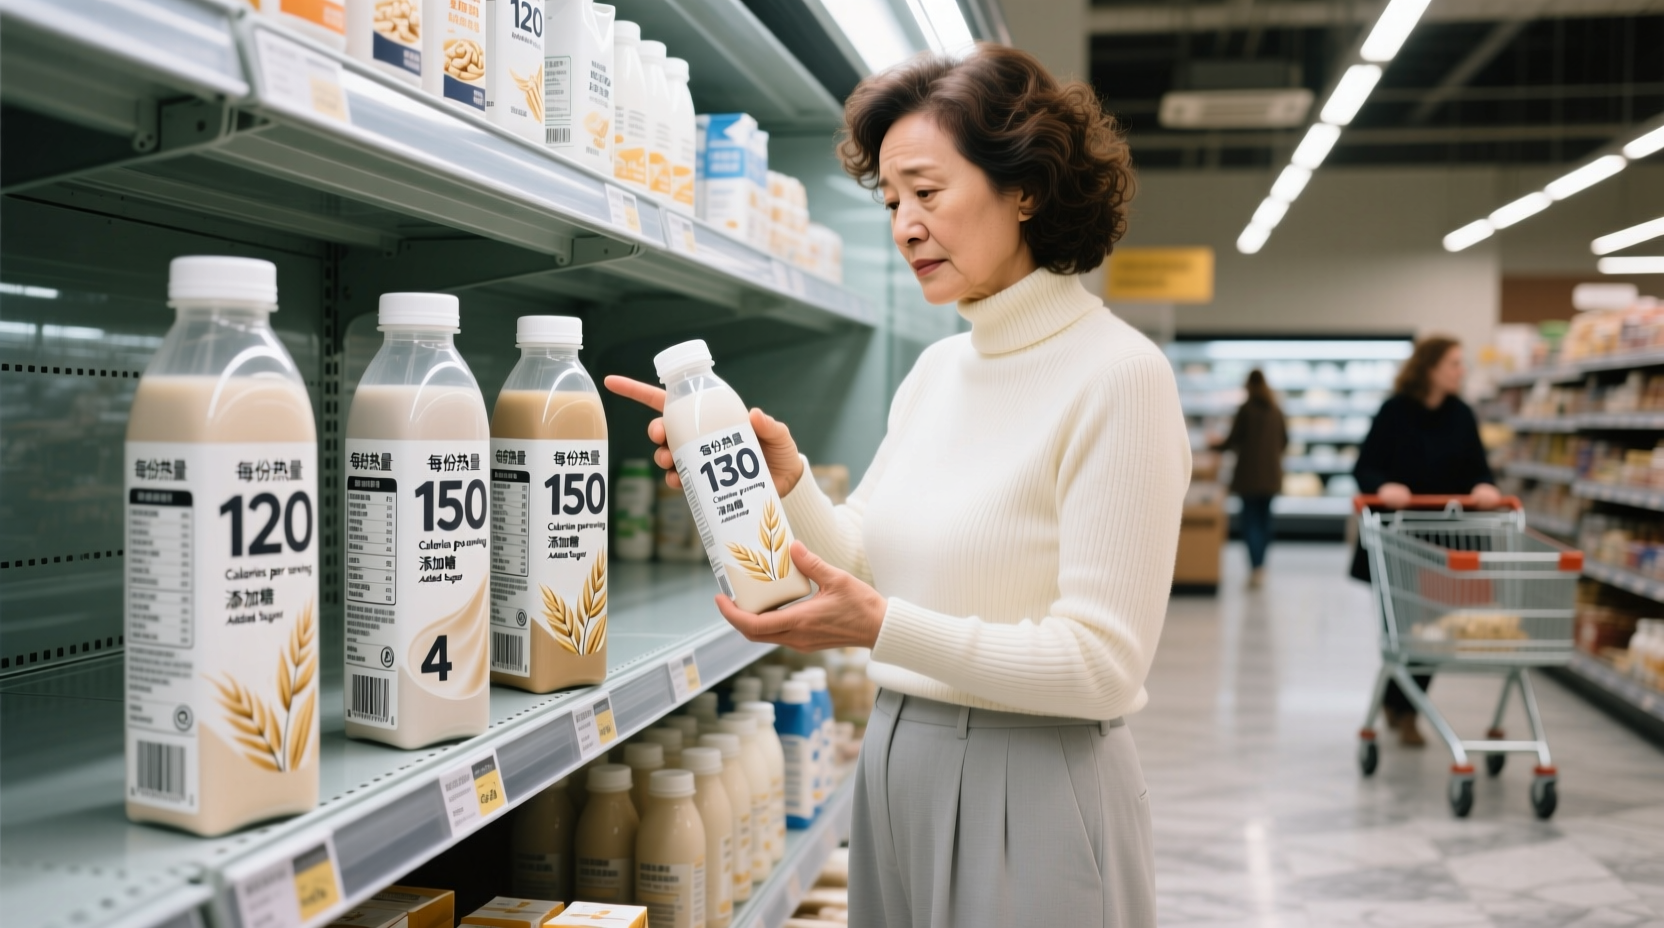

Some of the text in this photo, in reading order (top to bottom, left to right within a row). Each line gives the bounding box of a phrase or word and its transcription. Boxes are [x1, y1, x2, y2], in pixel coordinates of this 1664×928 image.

[510, 0, 543, 38] 120
[235, 459, 304, 482] 每份热量
[427, 452, 481, 472] 每份热量
[699, 447, 760, 493] 130
[415, 479, 488, 532] 150
[544, 472, 606, 515] 150
[219, 490, 313, 558] 120
[420, 635, 452, 681] 4
